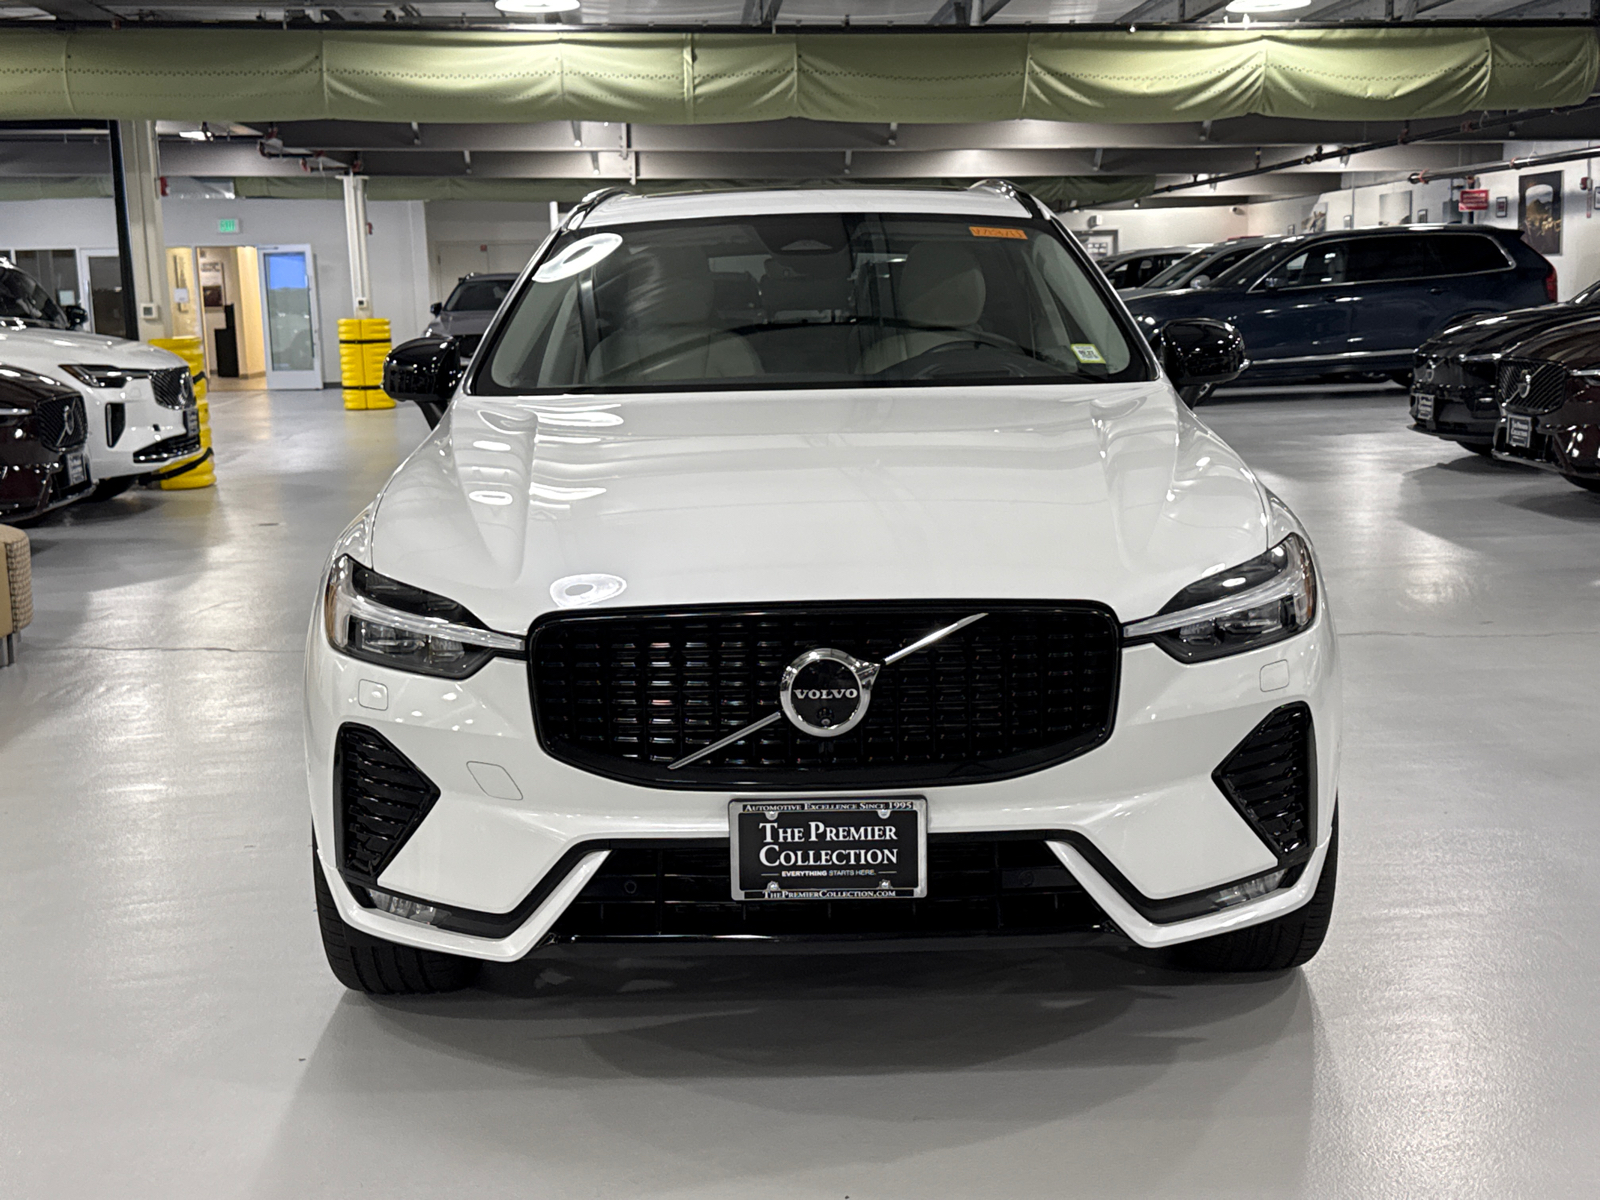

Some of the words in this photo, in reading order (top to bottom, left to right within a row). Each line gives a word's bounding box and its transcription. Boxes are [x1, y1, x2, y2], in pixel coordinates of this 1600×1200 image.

[793, 688, 858, 699] VOLVO
[744, 804, 802, 812] AUTOMOTIVE
[804, 803, 857, 811] EXCELLENCE
[859, 802, 885, 810] SINCE
[888, 801, 912, 809] 1995
[759, 822, 805, 843] THE
[808, 821, 898, 842] PREMIER
[759, 844, 898, 867] COLLECTION
